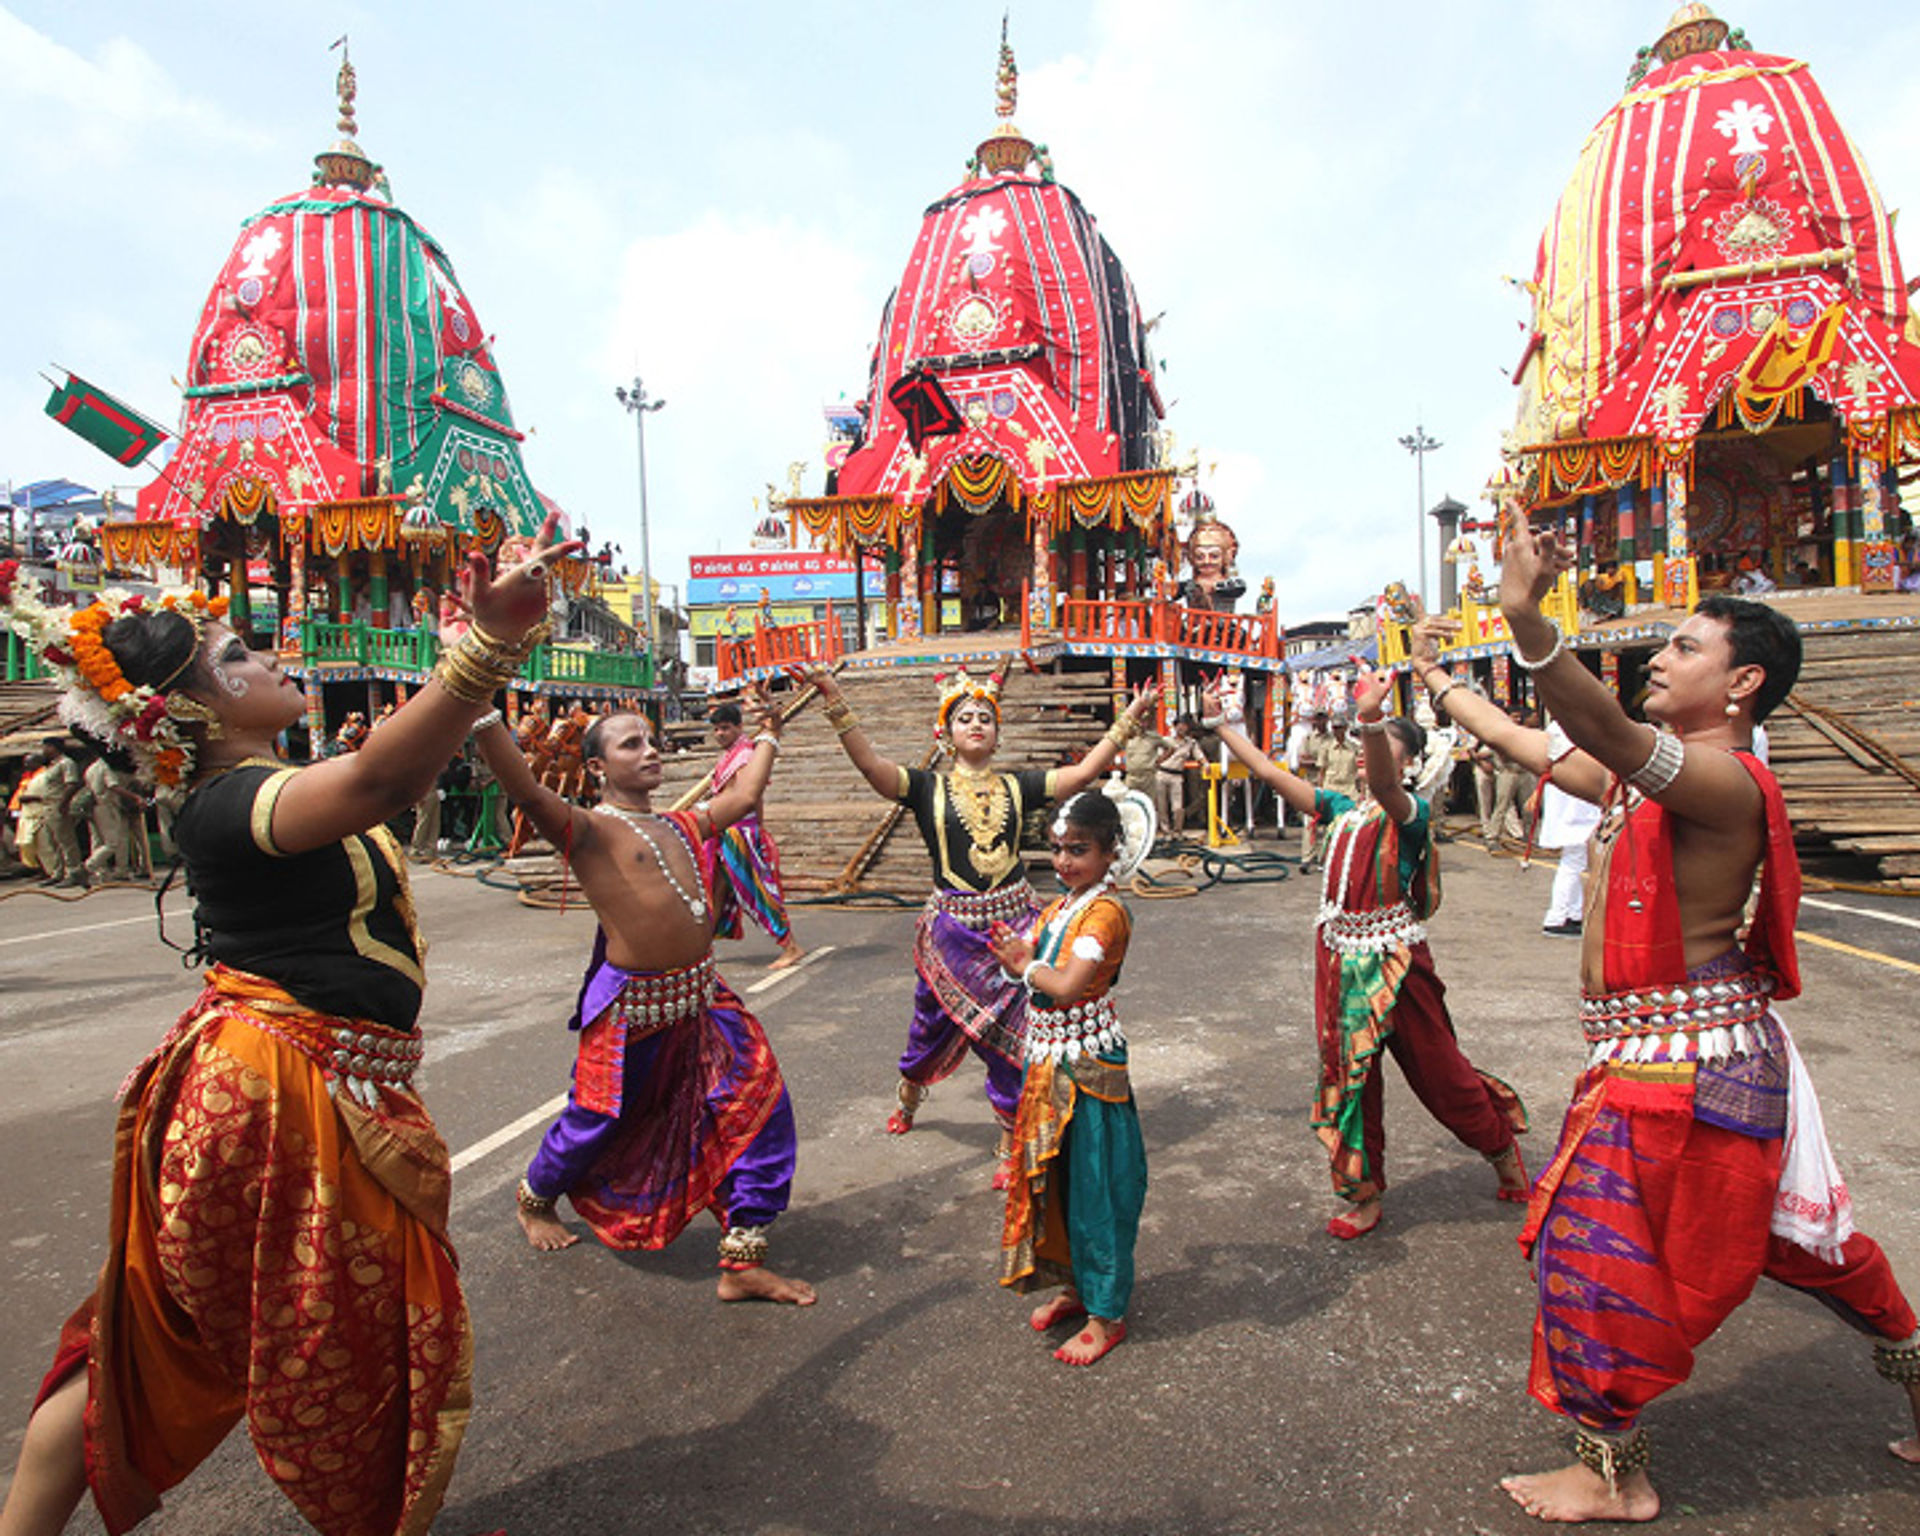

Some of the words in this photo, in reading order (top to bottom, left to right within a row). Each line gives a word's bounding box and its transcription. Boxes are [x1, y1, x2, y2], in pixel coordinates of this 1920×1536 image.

[704, 562, 734, 574] airtel
[737, 560, 755, 572] 4G
[770, 560, 799, 572] airtel
[803, 559, 821, 570] 4G
[794, 581, 812, 590] Jio
